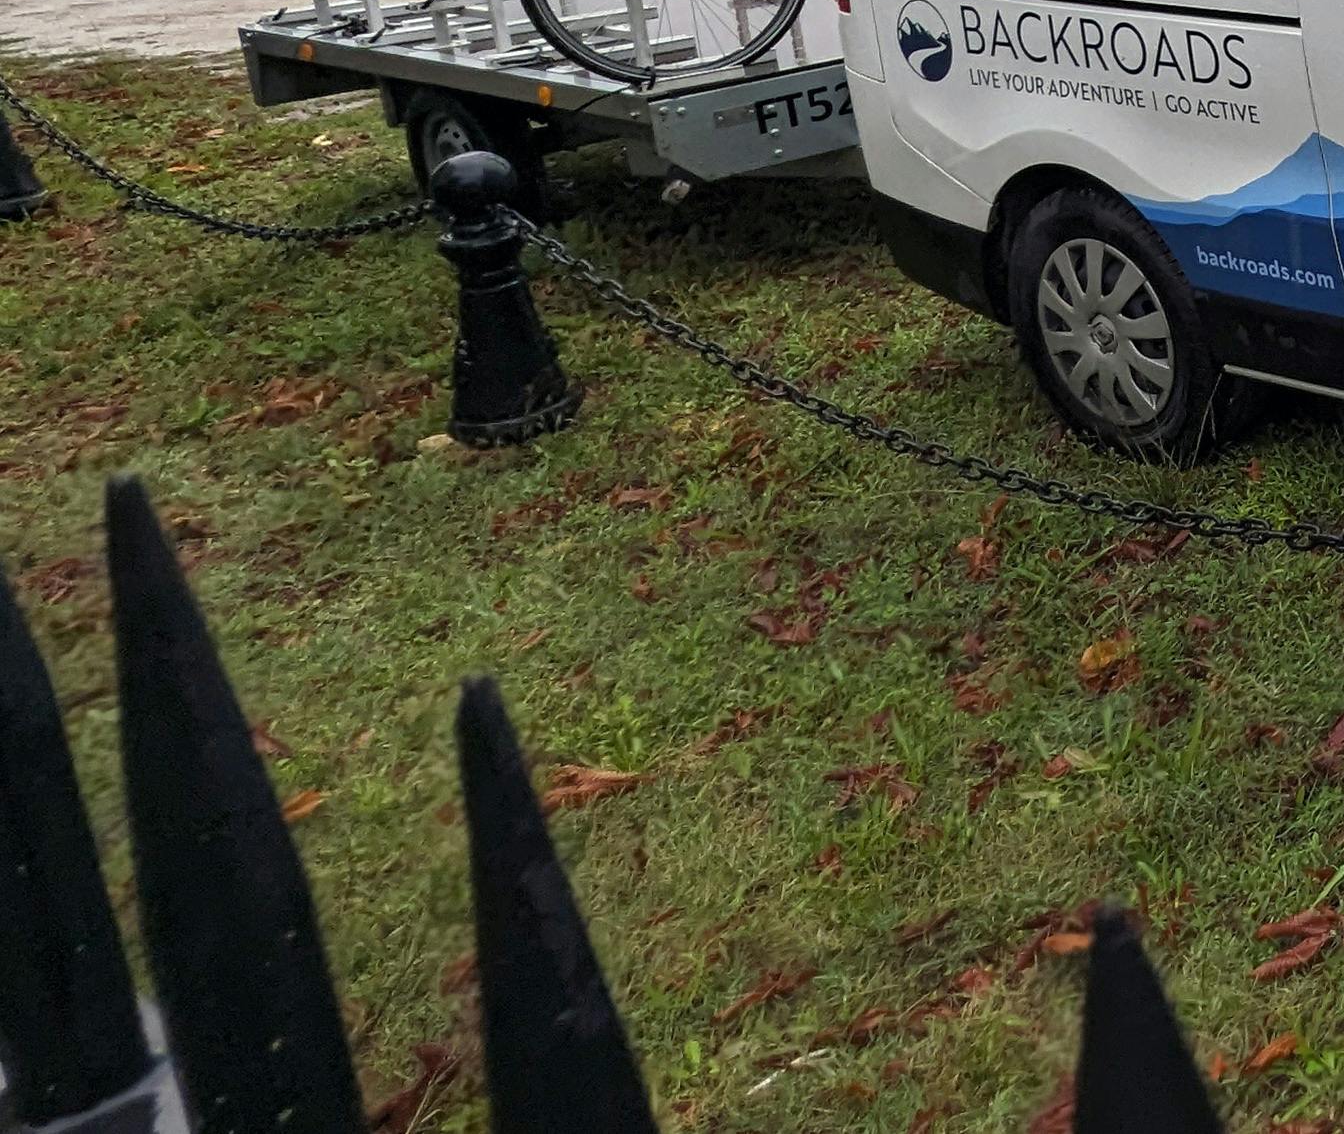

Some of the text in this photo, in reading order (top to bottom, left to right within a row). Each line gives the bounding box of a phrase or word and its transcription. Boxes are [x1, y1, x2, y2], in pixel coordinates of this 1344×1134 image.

[960, 5, 1252, 89] BACKROADS
[969, 68, 1001, 89] LIVE
[1002, 72, 1045, 96] YOUR
[1048, 78, 1146, 108] ADVENTURE
[1165, 94, 1192, 114] GO
[1197, 99, 1260, 124] ACTIVE
[1196, 245, 1336, 290] backroads.com
